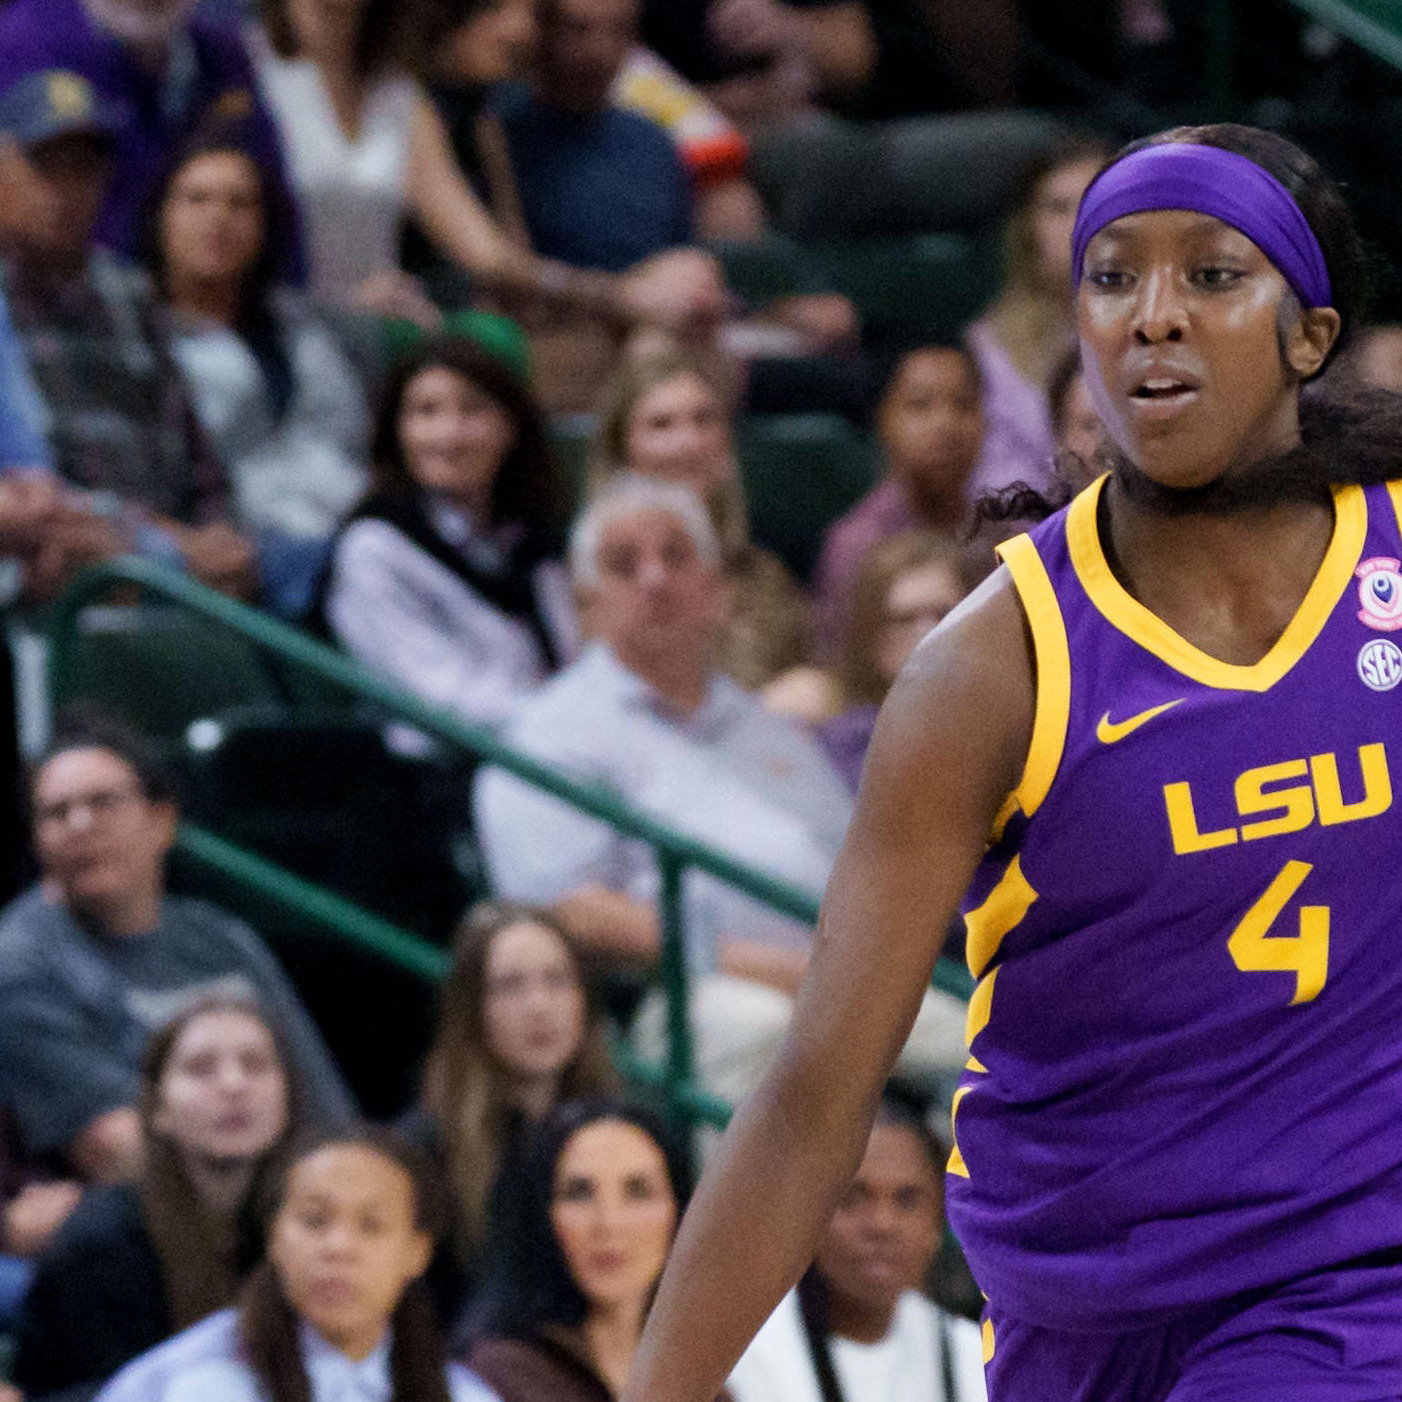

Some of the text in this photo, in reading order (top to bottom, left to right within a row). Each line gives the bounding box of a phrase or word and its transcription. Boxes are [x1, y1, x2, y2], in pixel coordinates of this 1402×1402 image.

[1360, 643, 1402, 687] SEC
[1163, 742, 1393, 856] LSU
[1227, 859, 1331, 1007] 4
